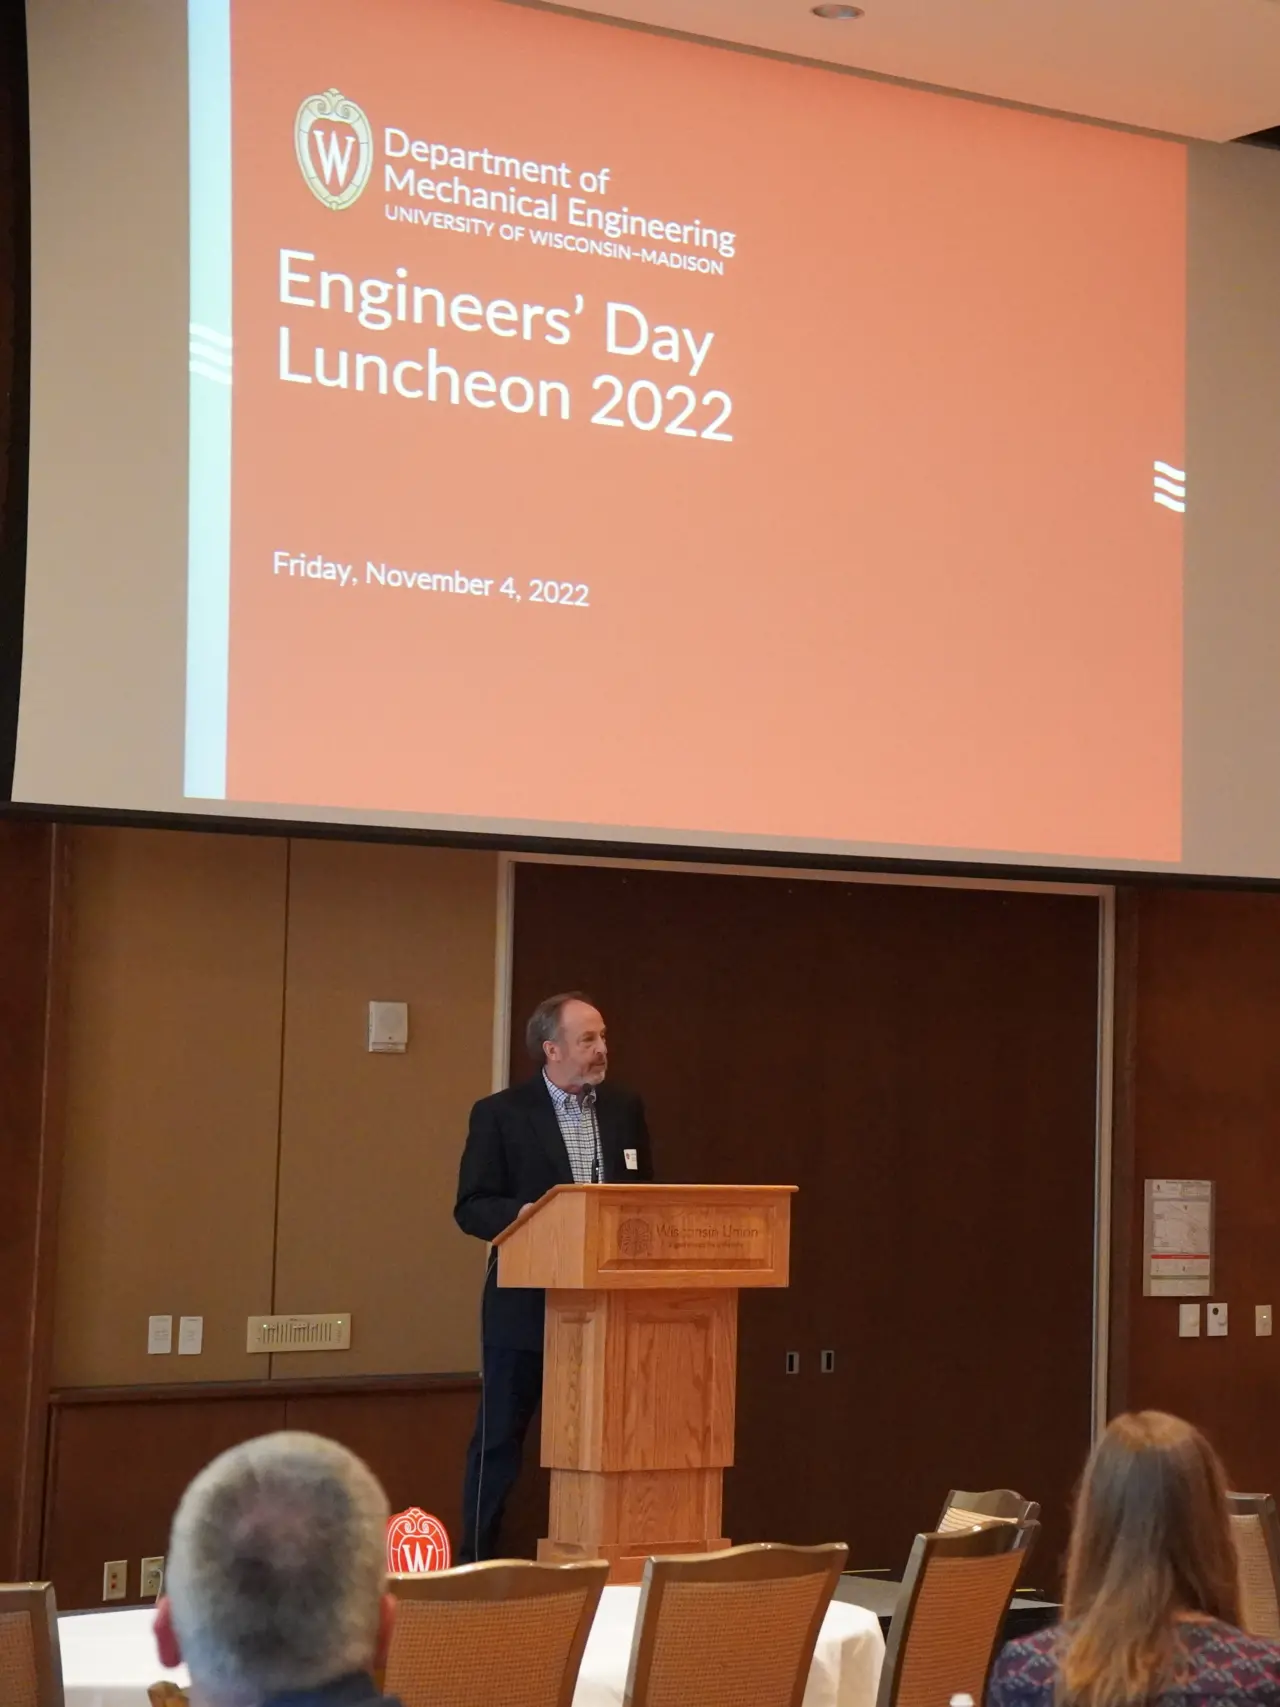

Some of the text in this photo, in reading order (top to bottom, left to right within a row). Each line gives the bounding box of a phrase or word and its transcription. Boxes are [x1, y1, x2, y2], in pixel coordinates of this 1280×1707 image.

[313, 130, 356, 188] W
[384, 127, 610, 195] Department of
[384, 164, 736, 257] Mechanical Engineering
[385, 204, 494, 237] UNIVERSITY
[500, 223, 525, 242] OF
[279, 248, 715, 377] Engineers’ Day
[279, 326, 733, 442] Luncheon 2022
[273, 551, 590, 607] Friday, November 4, 2022
[401, 1541, 434, 1573] W
